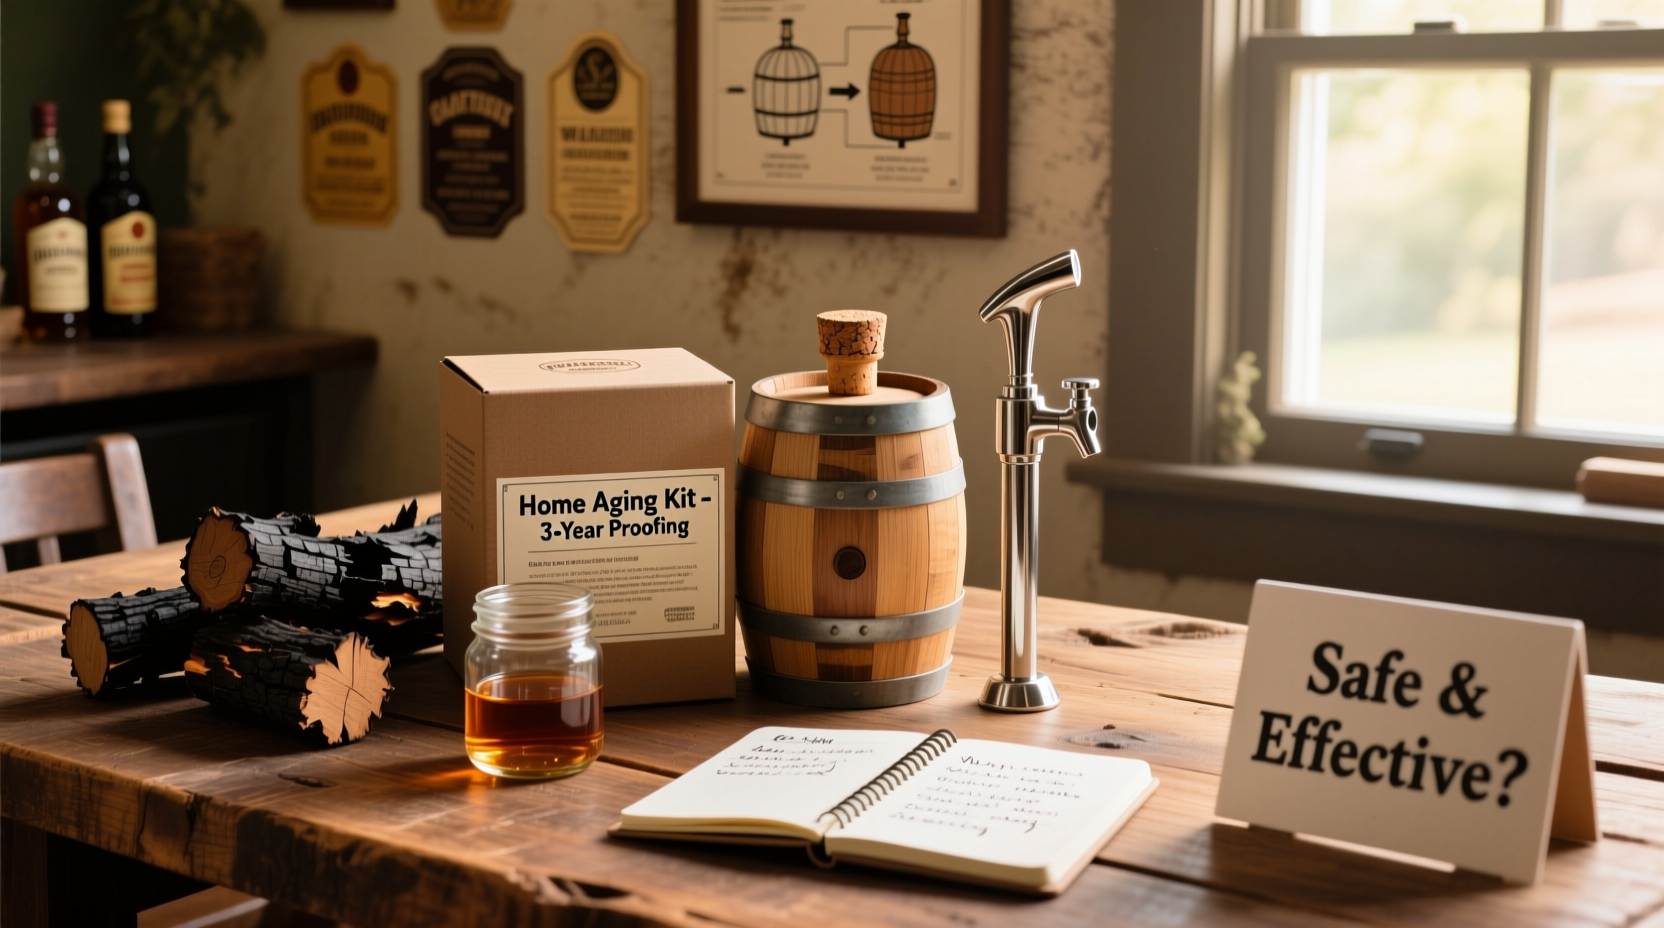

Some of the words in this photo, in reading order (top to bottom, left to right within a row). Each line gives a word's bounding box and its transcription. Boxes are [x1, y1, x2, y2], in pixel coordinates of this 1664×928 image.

[519, 494, 586, 517] Home
[593, 489, 658, 518] Aging
[664, 486, 697, 510] Kit
[540, 520, 605, 542] 3-Year
[609, 516, 690, 539] Proofing
[1306, 641, 1423, 709] Safe
[1438, 661, 1489, 720] &
[1250, 710, 1530, 809] Effective?
